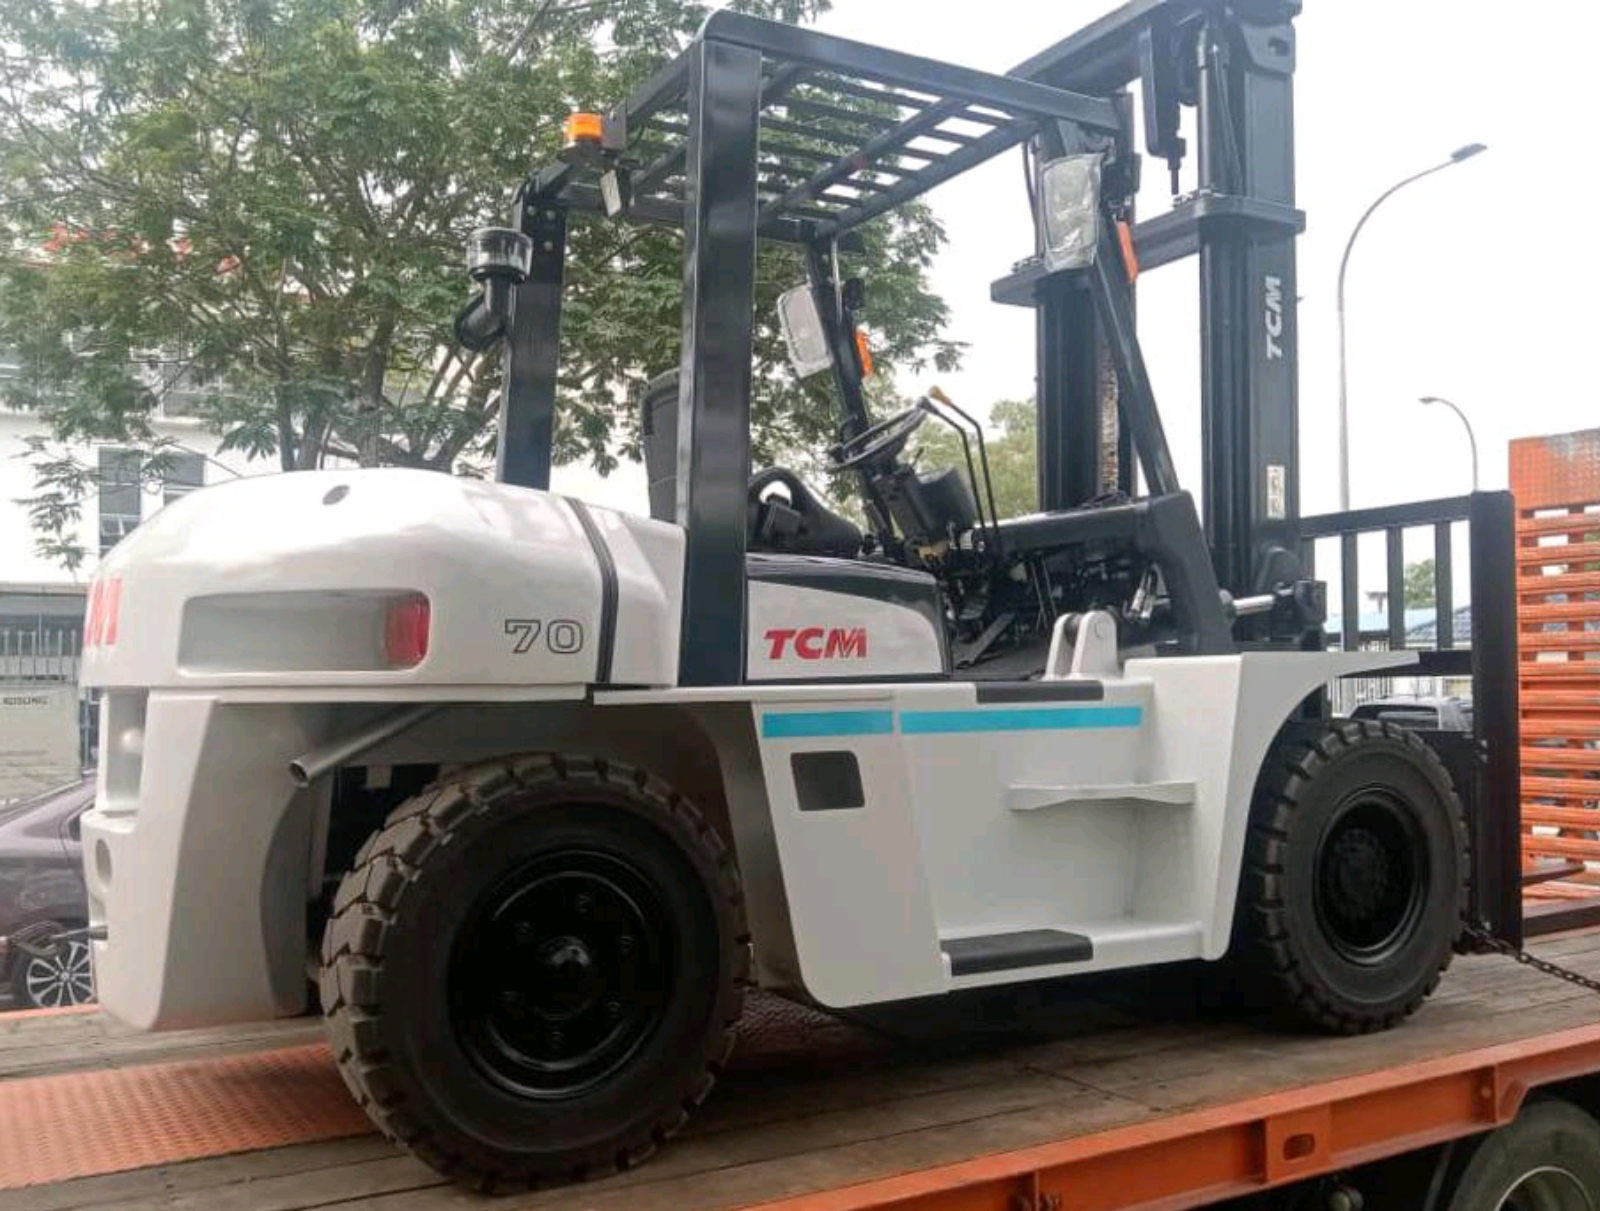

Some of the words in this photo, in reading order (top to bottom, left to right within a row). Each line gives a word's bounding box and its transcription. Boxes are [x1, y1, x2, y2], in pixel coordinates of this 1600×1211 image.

[1265, 276, 1282, 360] TCM
[505, 619, 584, 654] 70
[763, 628, 867, 660] TCM
